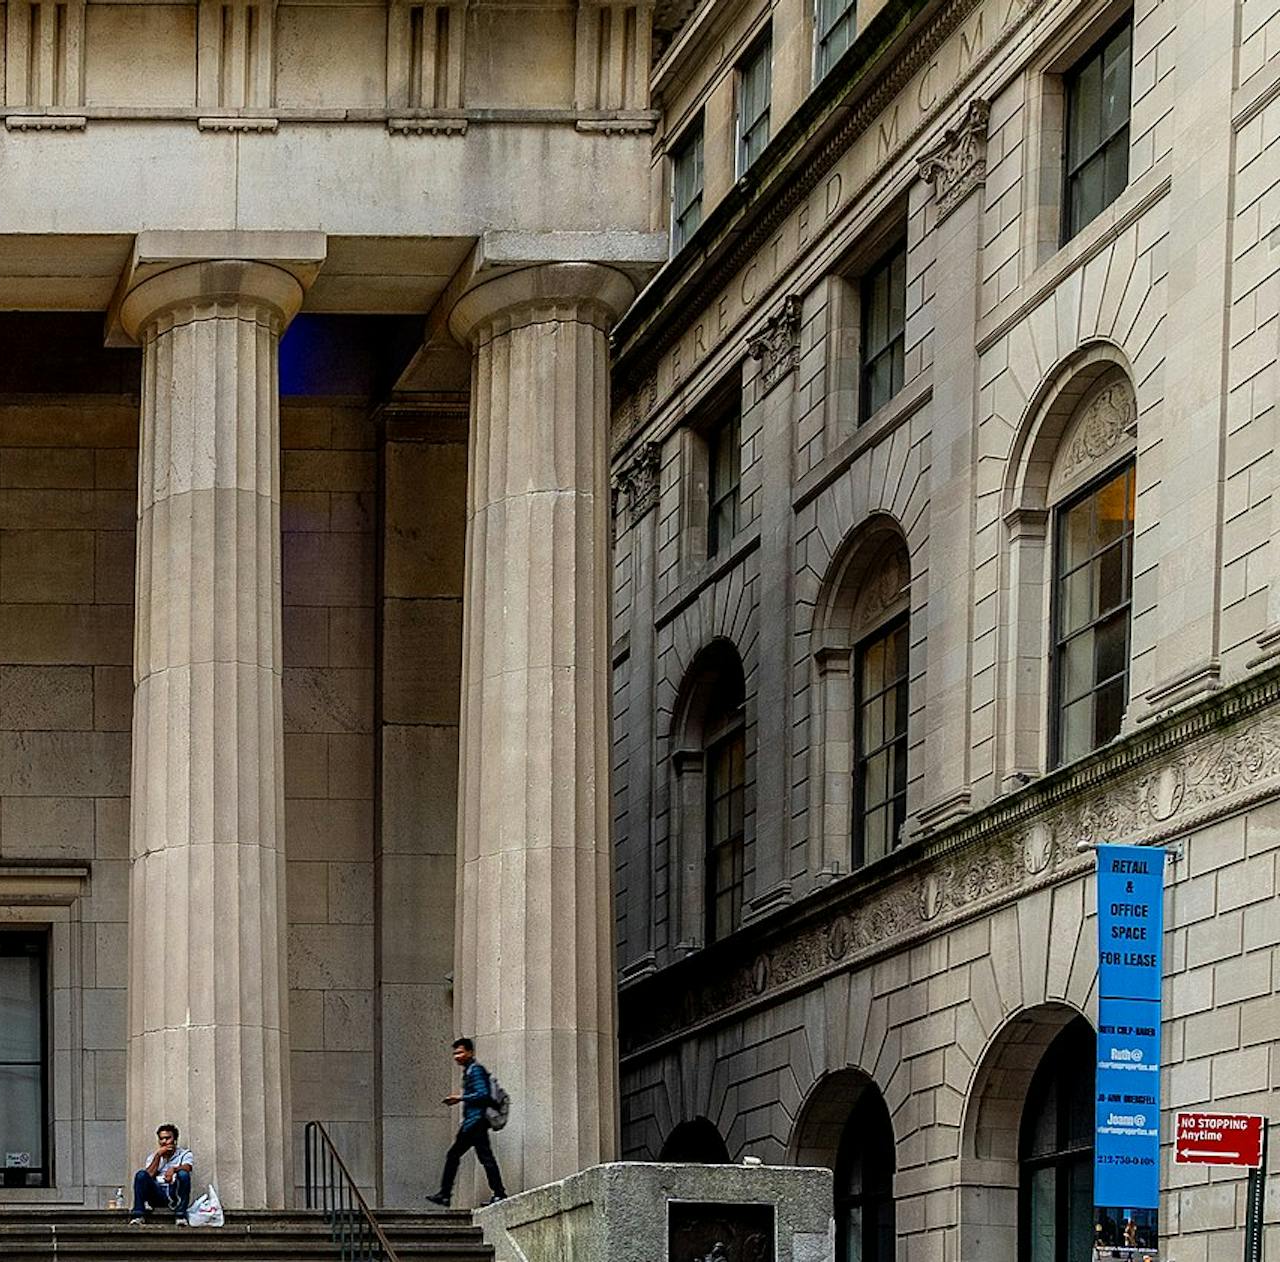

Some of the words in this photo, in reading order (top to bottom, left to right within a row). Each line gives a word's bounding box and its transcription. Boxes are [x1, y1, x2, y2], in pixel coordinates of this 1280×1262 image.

[672, 173, 842, 384] ERECTED
[1112, 859, 1148, 874] RETAIL
[1125, 881, 1134, 893] &
[1110, 903, 1148, 917] OFFICE
[1111, 926, 1146, 940] SPACE
[1100, 952, 1120, 965] FOR
[1124, 952, 1156, 967] LEASE
[1181, 1117, 1195, 1128] NO
[1198, 1118, 1248, 1130] STOPPING
[1181, 1129, 1222, 1141] Anytime
